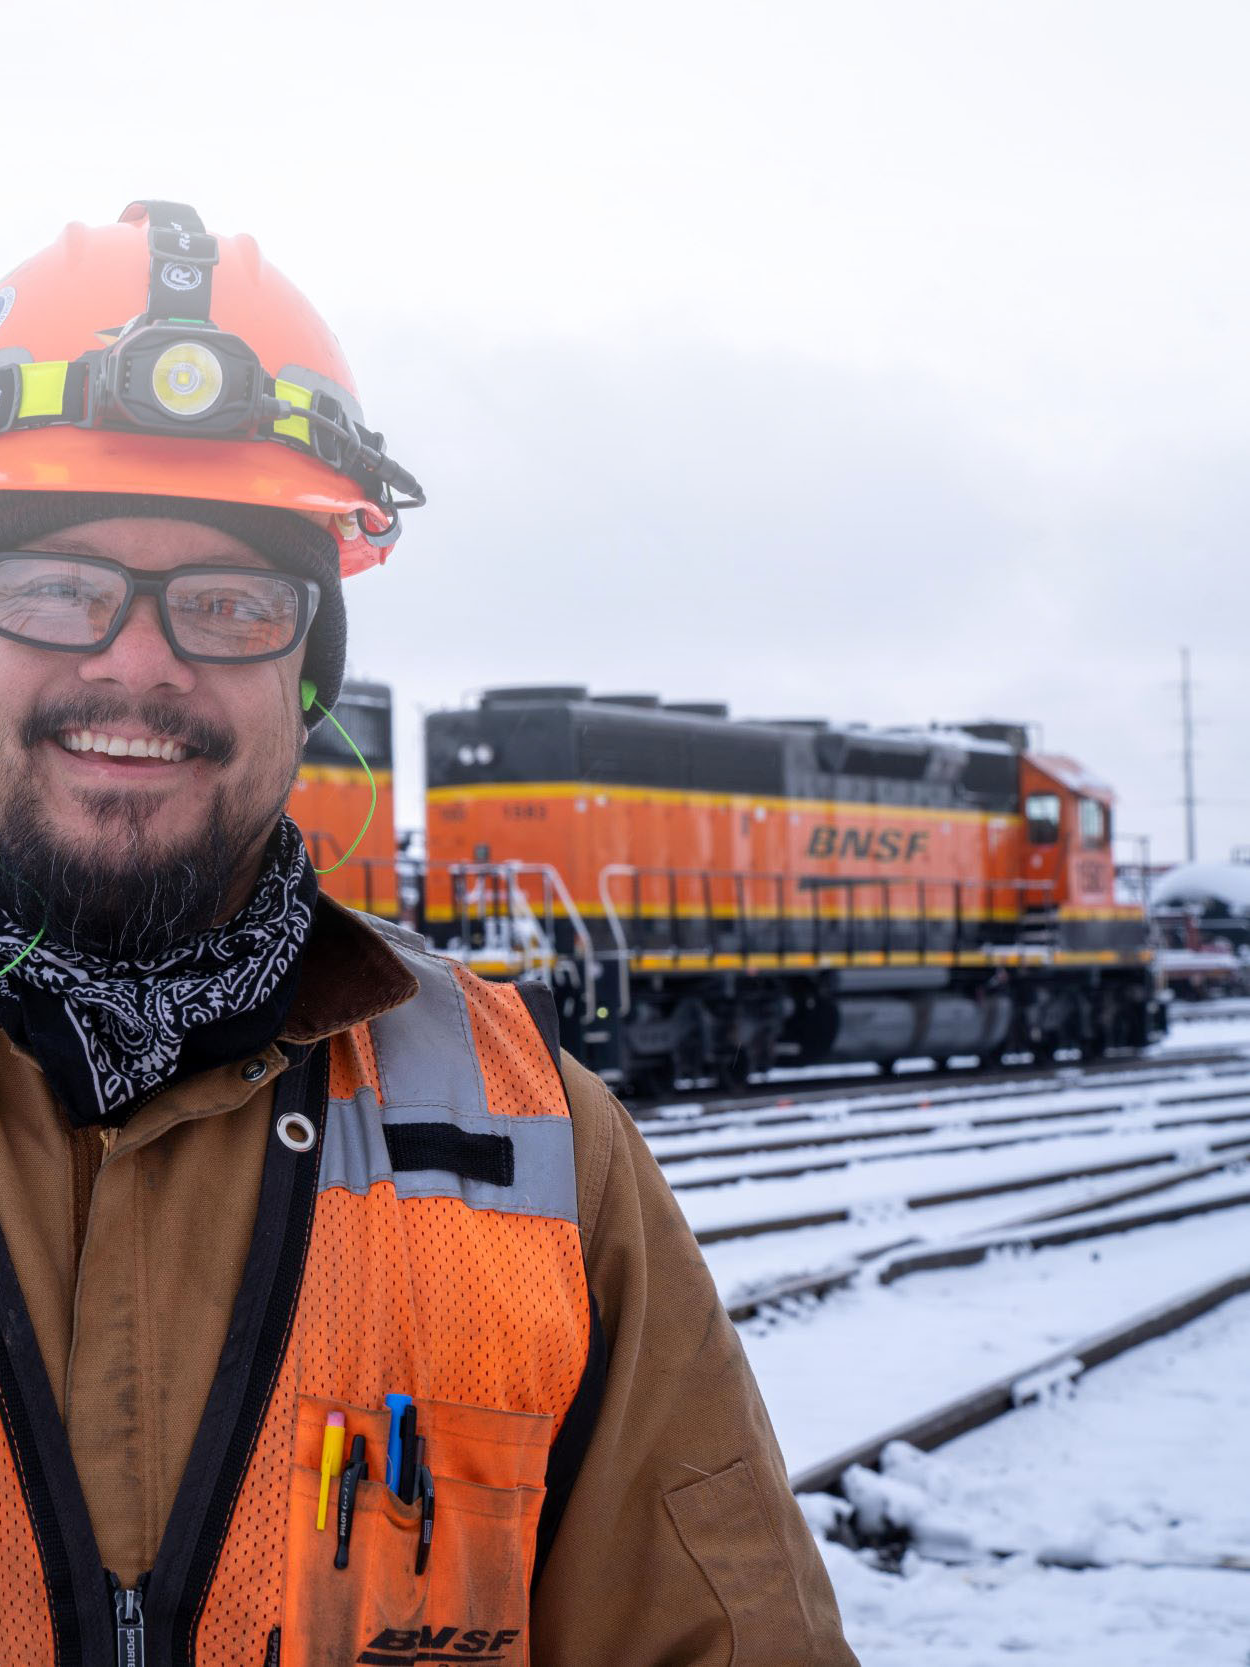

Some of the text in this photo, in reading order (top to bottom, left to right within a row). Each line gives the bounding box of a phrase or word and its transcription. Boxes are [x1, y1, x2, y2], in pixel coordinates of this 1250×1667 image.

[807, 827, 930, 862] BNSF
[339, 1512, 347, 1536] PILOT
[366, 1625, 520, 1653] BNSF
